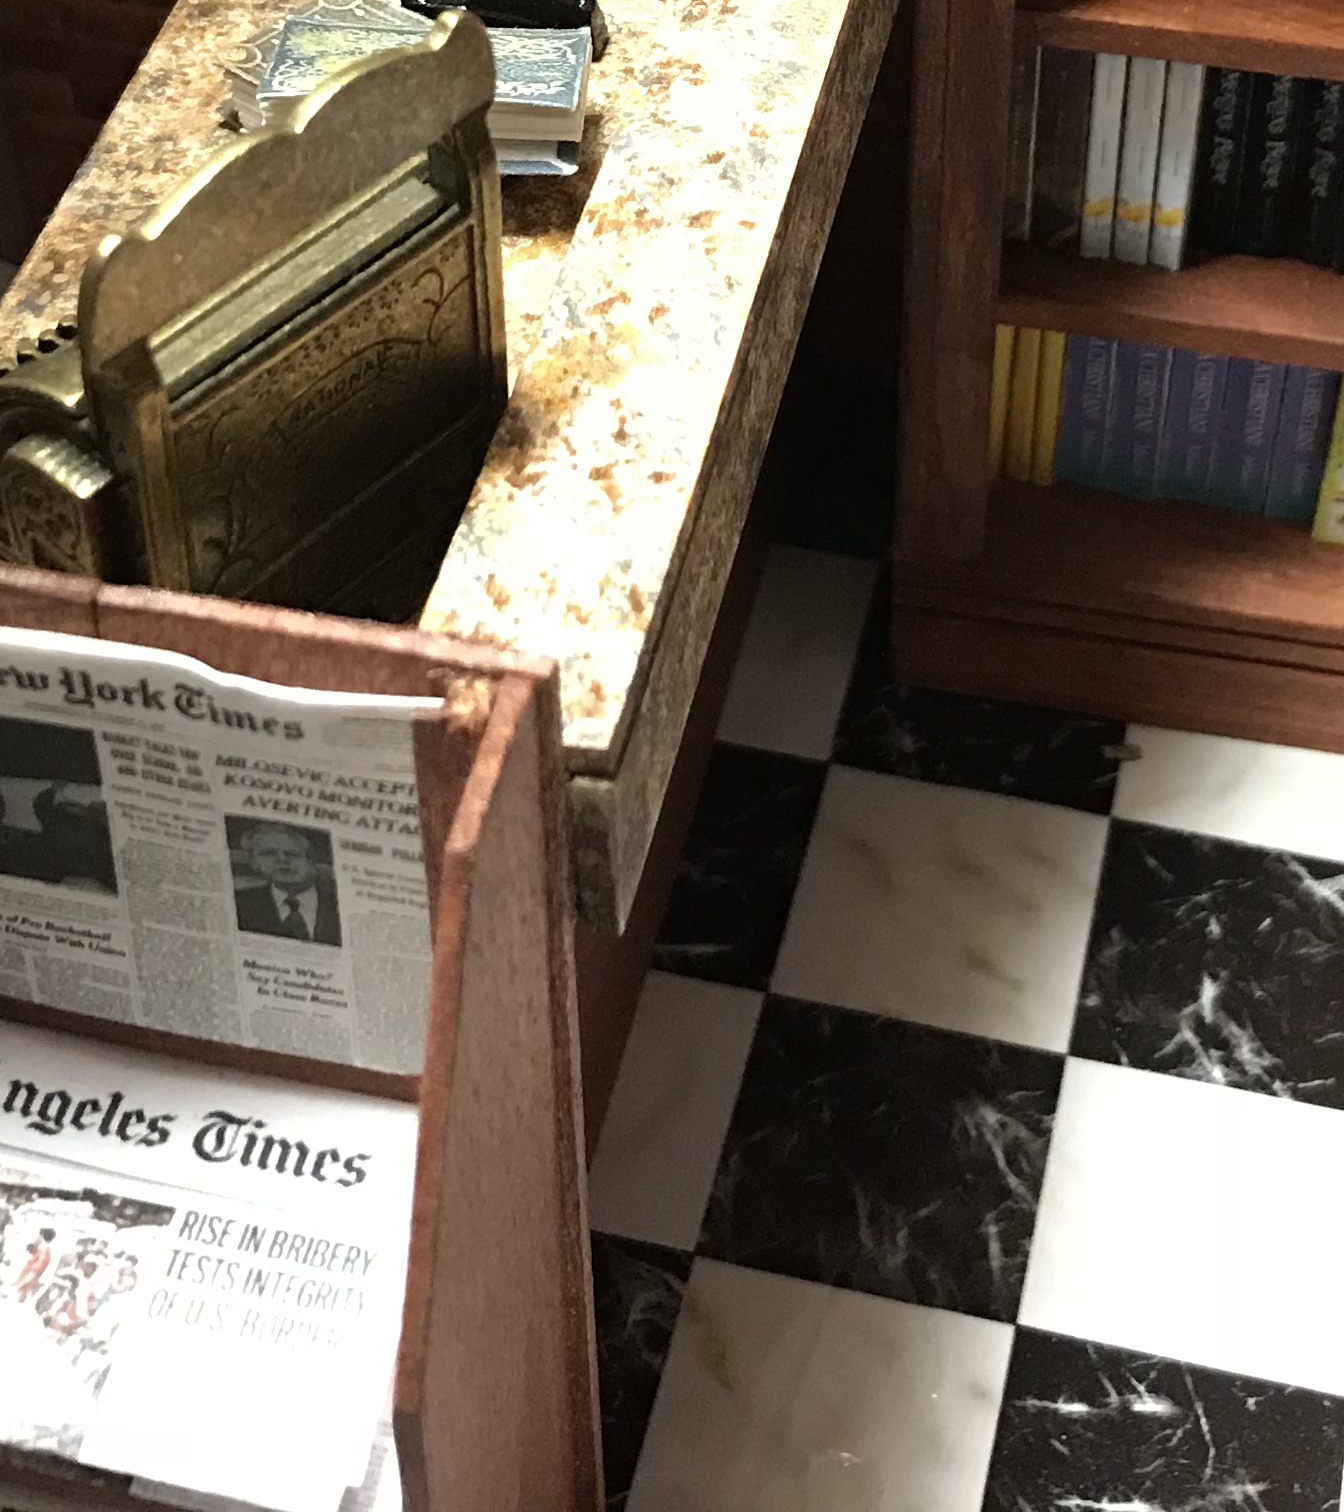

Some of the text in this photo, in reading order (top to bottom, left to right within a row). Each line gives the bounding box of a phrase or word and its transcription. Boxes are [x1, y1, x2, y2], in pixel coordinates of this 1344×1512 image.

[59, 666, 167, 710] York
[174, 682, 305, 740] Times
[215, 753, 332, 785] MILOSEVIC
[224, 772, 313, 797] KOSOVO
[242, 795, 351, 824] AVERTING
[193, 1110, 373, 1190] Times
[178, 1210, 378, 1276] RISE IN BRIBERY
[166, 1248, 365, 1319] TESTS INTEGRITY
